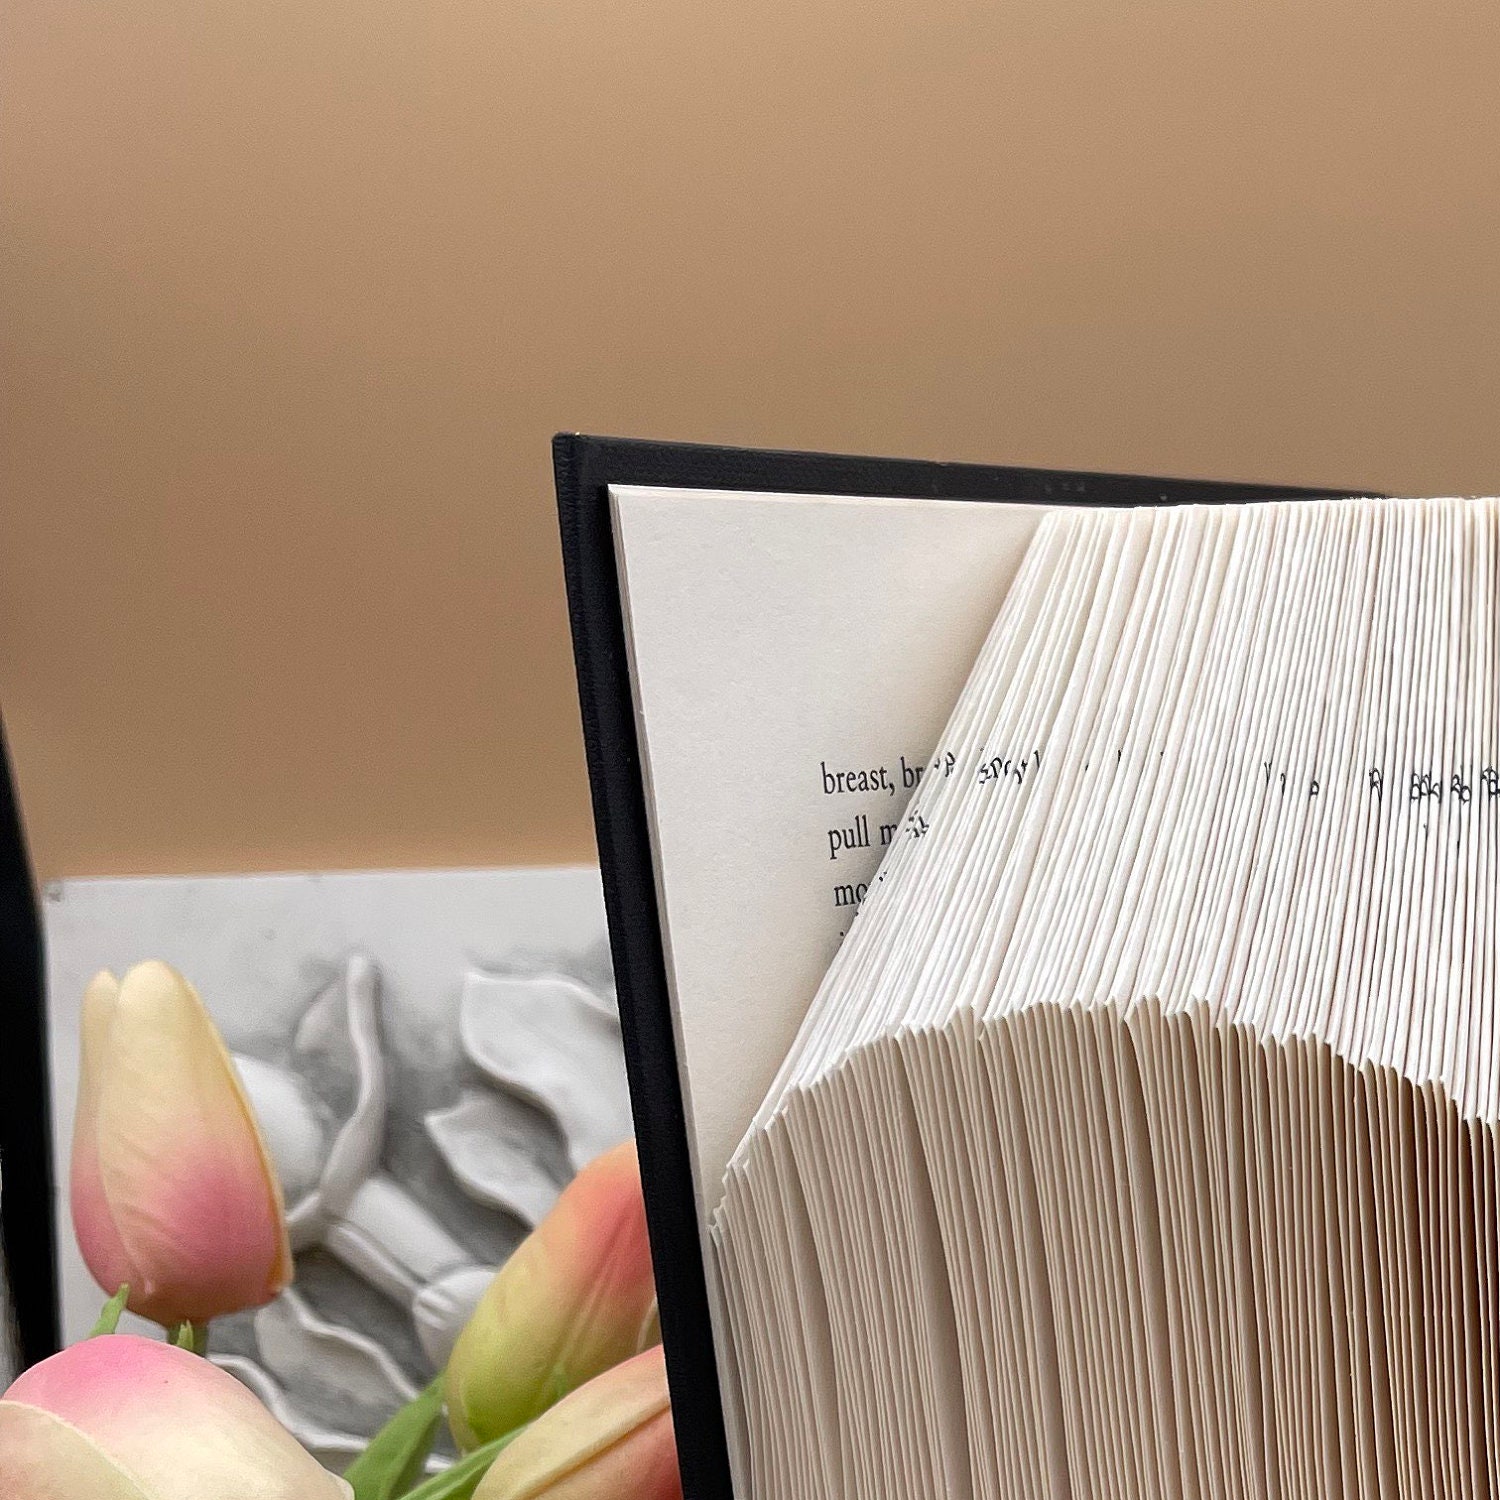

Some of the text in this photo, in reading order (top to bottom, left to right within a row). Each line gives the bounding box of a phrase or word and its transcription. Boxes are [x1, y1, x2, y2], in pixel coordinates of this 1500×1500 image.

[820, 761, 895, 796] breast,
[901, 756, 925, 788] br
[828, 815, 870, 860] pull
